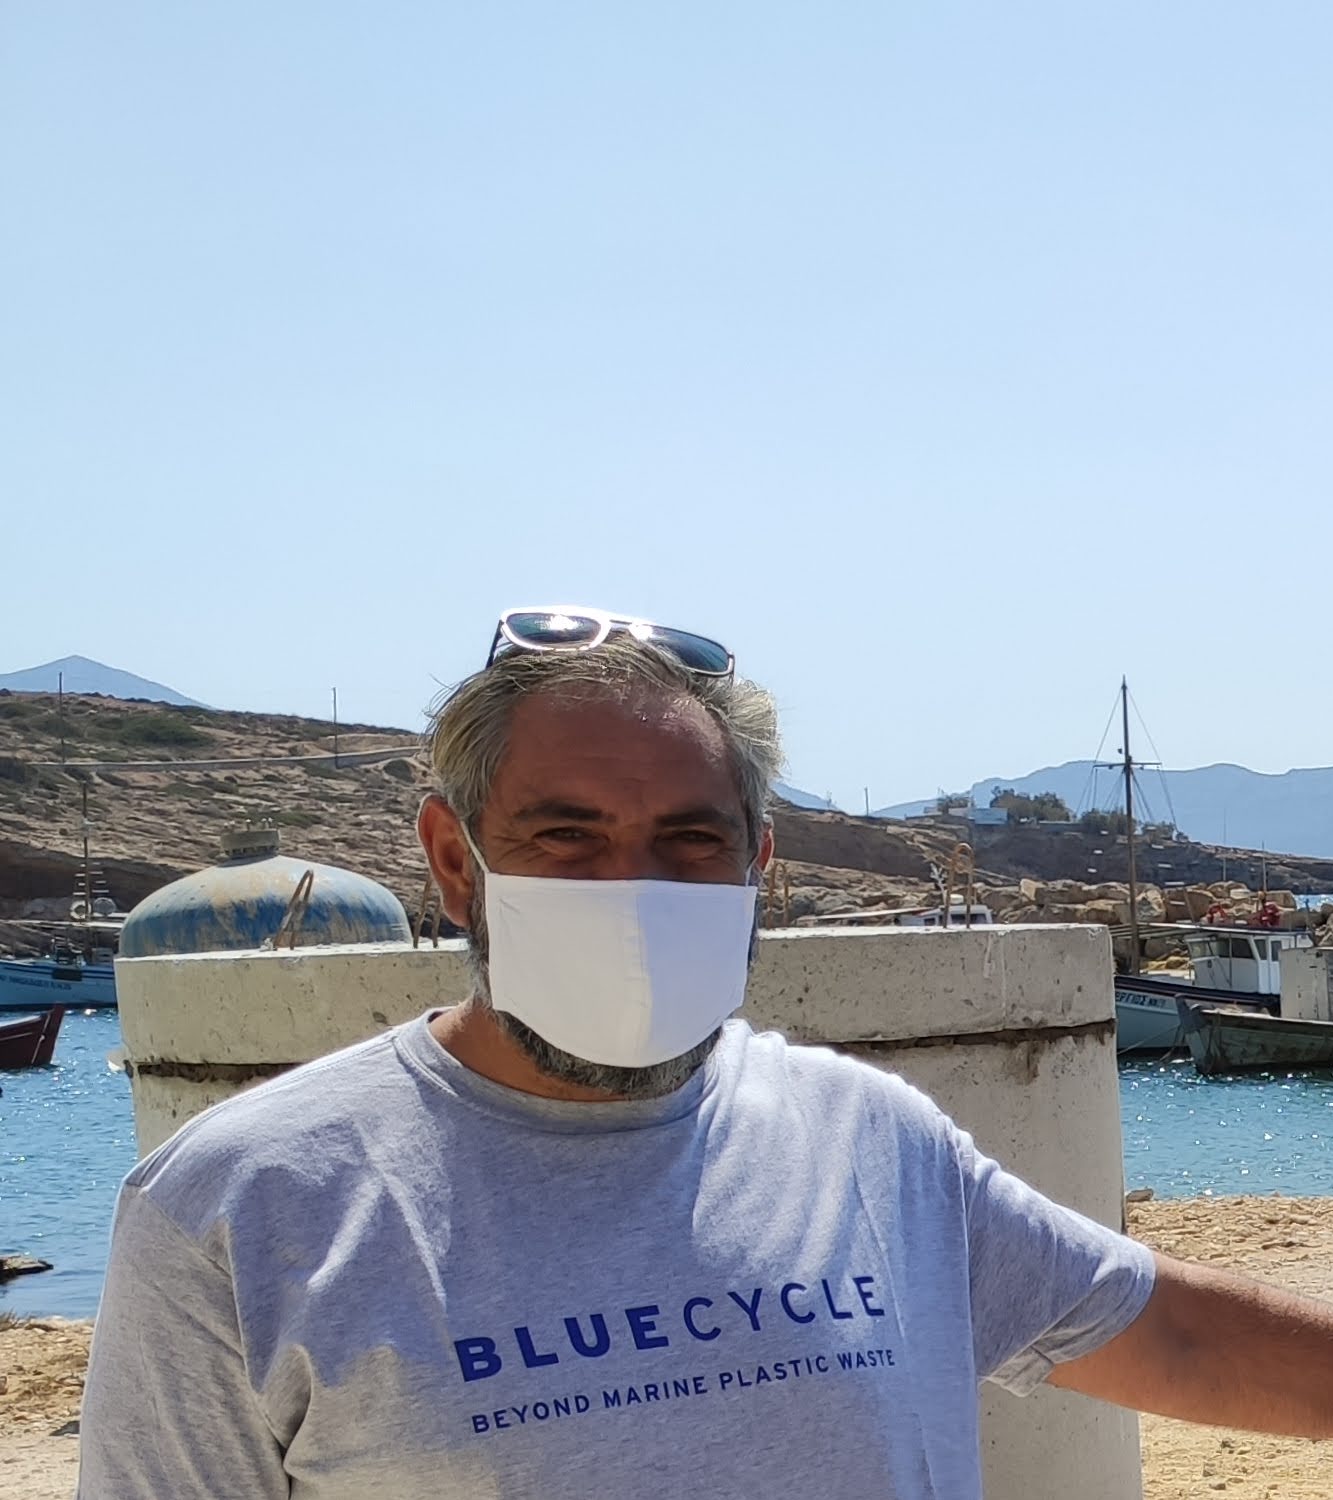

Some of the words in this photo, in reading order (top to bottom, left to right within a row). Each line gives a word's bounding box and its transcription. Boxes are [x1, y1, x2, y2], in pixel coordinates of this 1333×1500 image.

[453, 1275, 886, 1383] BLUECYCLE
[471, 1394, 590, 1434] BEYOND
[602, 1375, 708, 1409] MARINE
[718, 1355, 829, 1391] PLASTIC
[836, 1348, 895, 1371] WASTE
